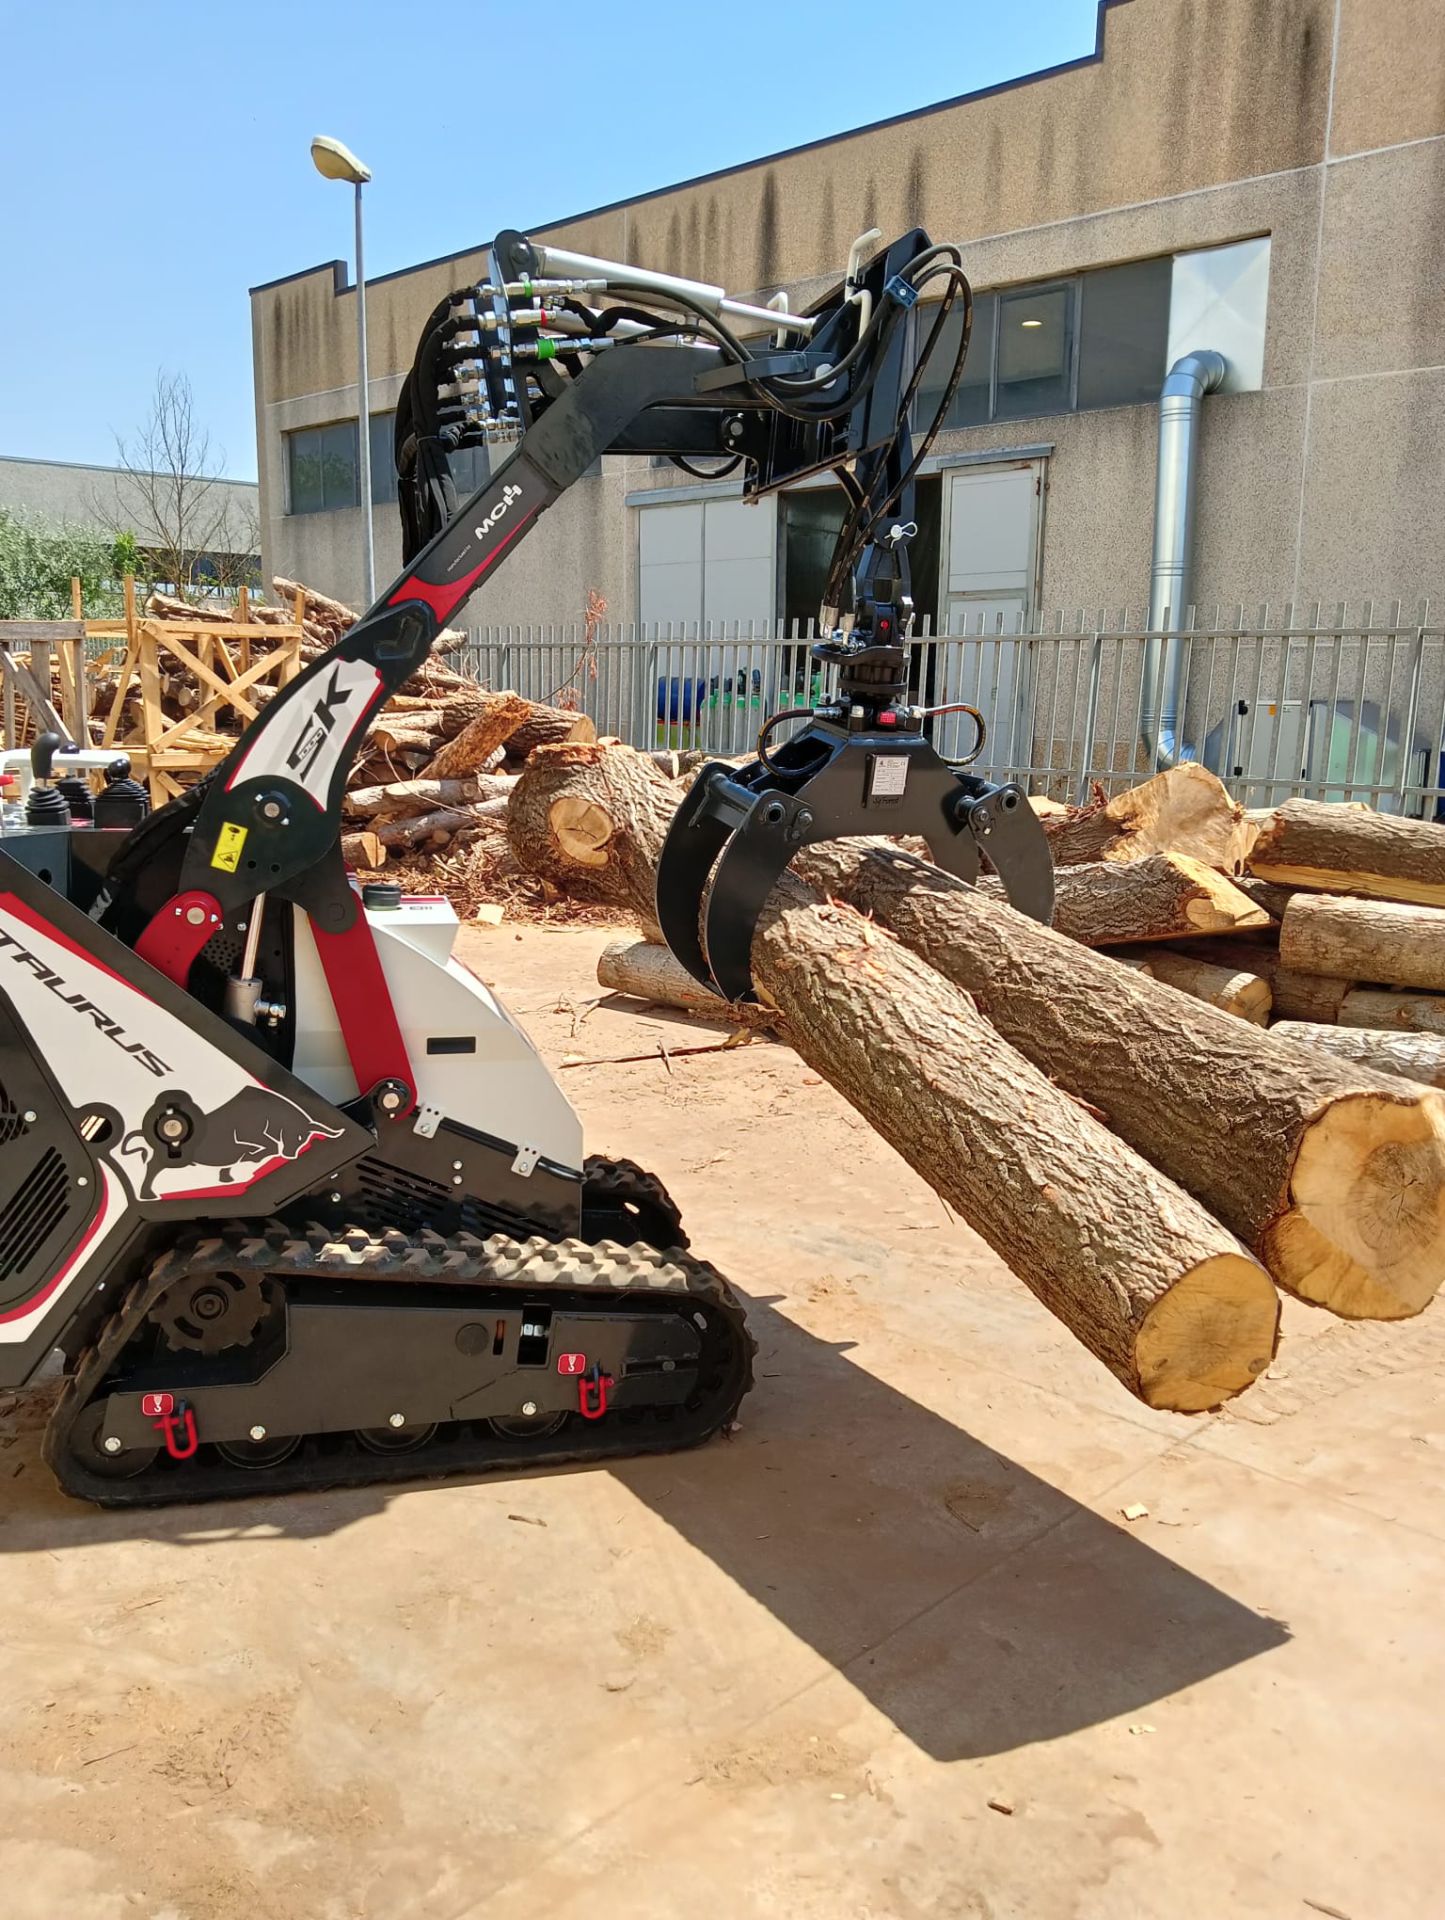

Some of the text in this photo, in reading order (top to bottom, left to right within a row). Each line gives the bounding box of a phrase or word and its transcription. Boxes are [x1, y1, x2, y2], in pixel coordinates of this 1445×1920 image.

[475, 484, 523, 540] MCH
[286, 664, 353, 784] SK
[0, 928, 175, 1078] TAURUS
